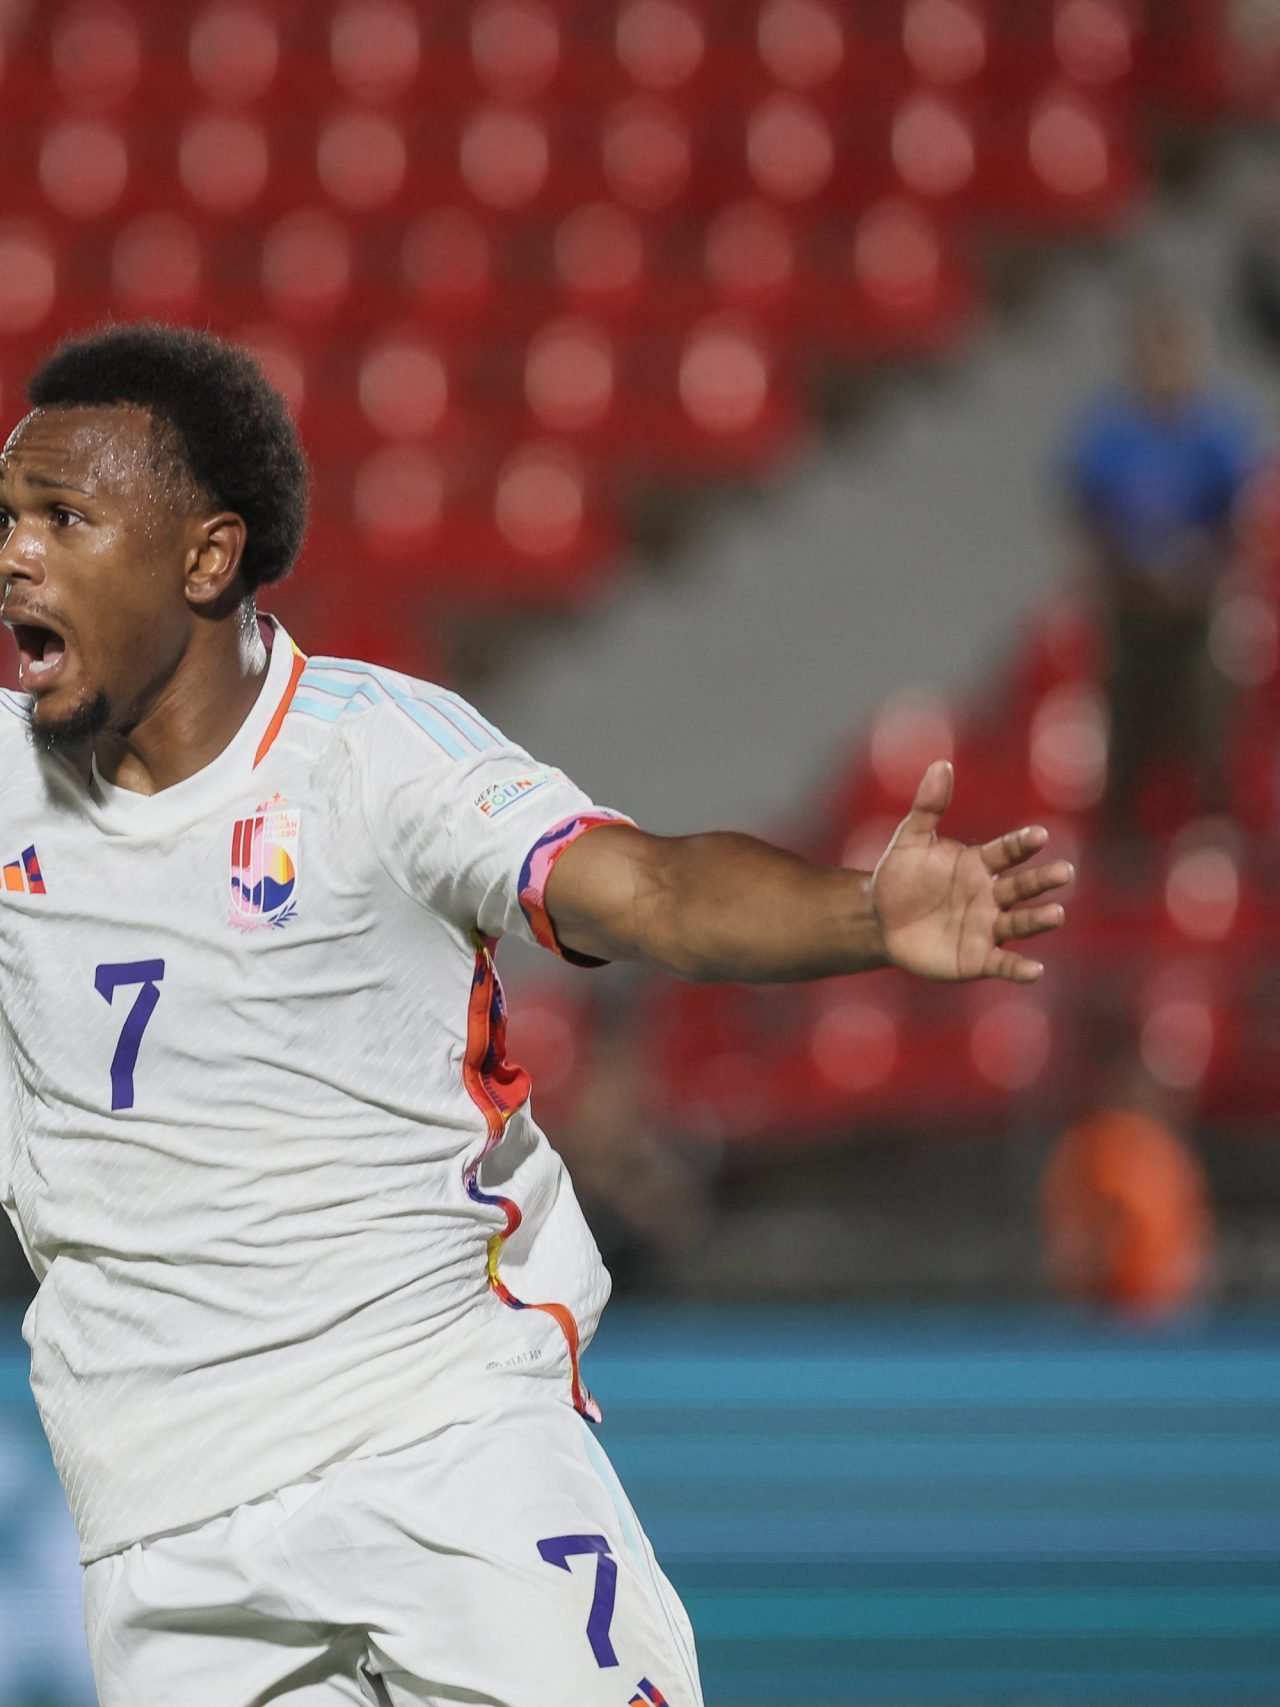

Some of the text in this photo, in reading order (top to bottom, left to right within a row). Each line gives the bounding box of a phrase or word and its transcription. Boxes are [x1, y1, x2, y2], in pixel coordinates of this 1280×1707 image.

[479, 777, 540, 816] FOUN
[94, 958, 166, 1112] 7
[536, 1534, 620, 1669] 7
